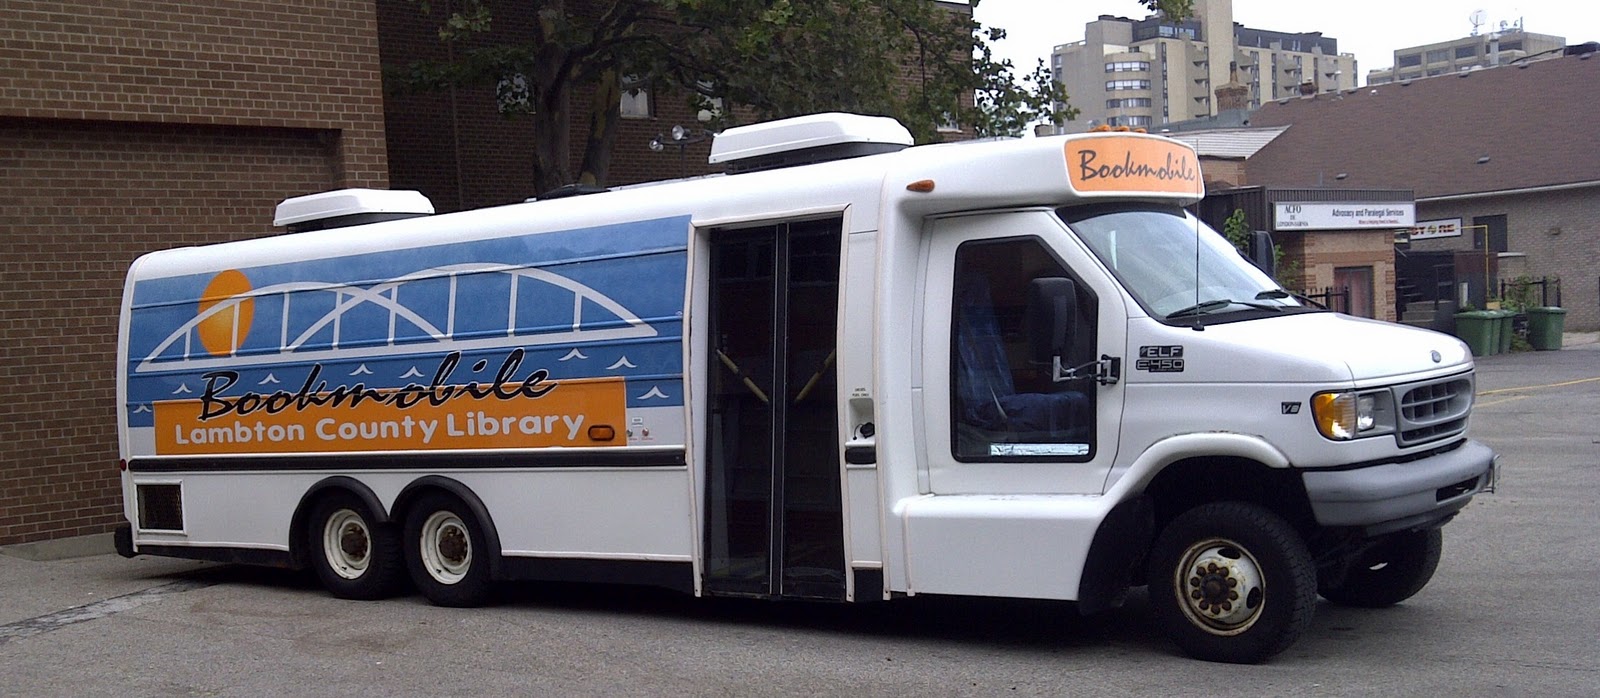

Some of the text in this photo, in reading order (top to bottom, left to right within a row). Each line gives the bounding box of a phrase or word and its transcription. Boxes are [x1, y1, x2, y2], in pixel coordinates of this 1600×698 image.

[1078, 149, 1195, 181] Bookmobile
[1284, 204, 1302, 214] ACFO
[1332, 208, 1354, 218] Advocacy
[1364, 208, 1385, 218] Paralegal
[1386, 208, 1404, 217] Services
[198, 347, 558, 421] Bookmobile
[175, 410, 584, 445] Lambton County Library
